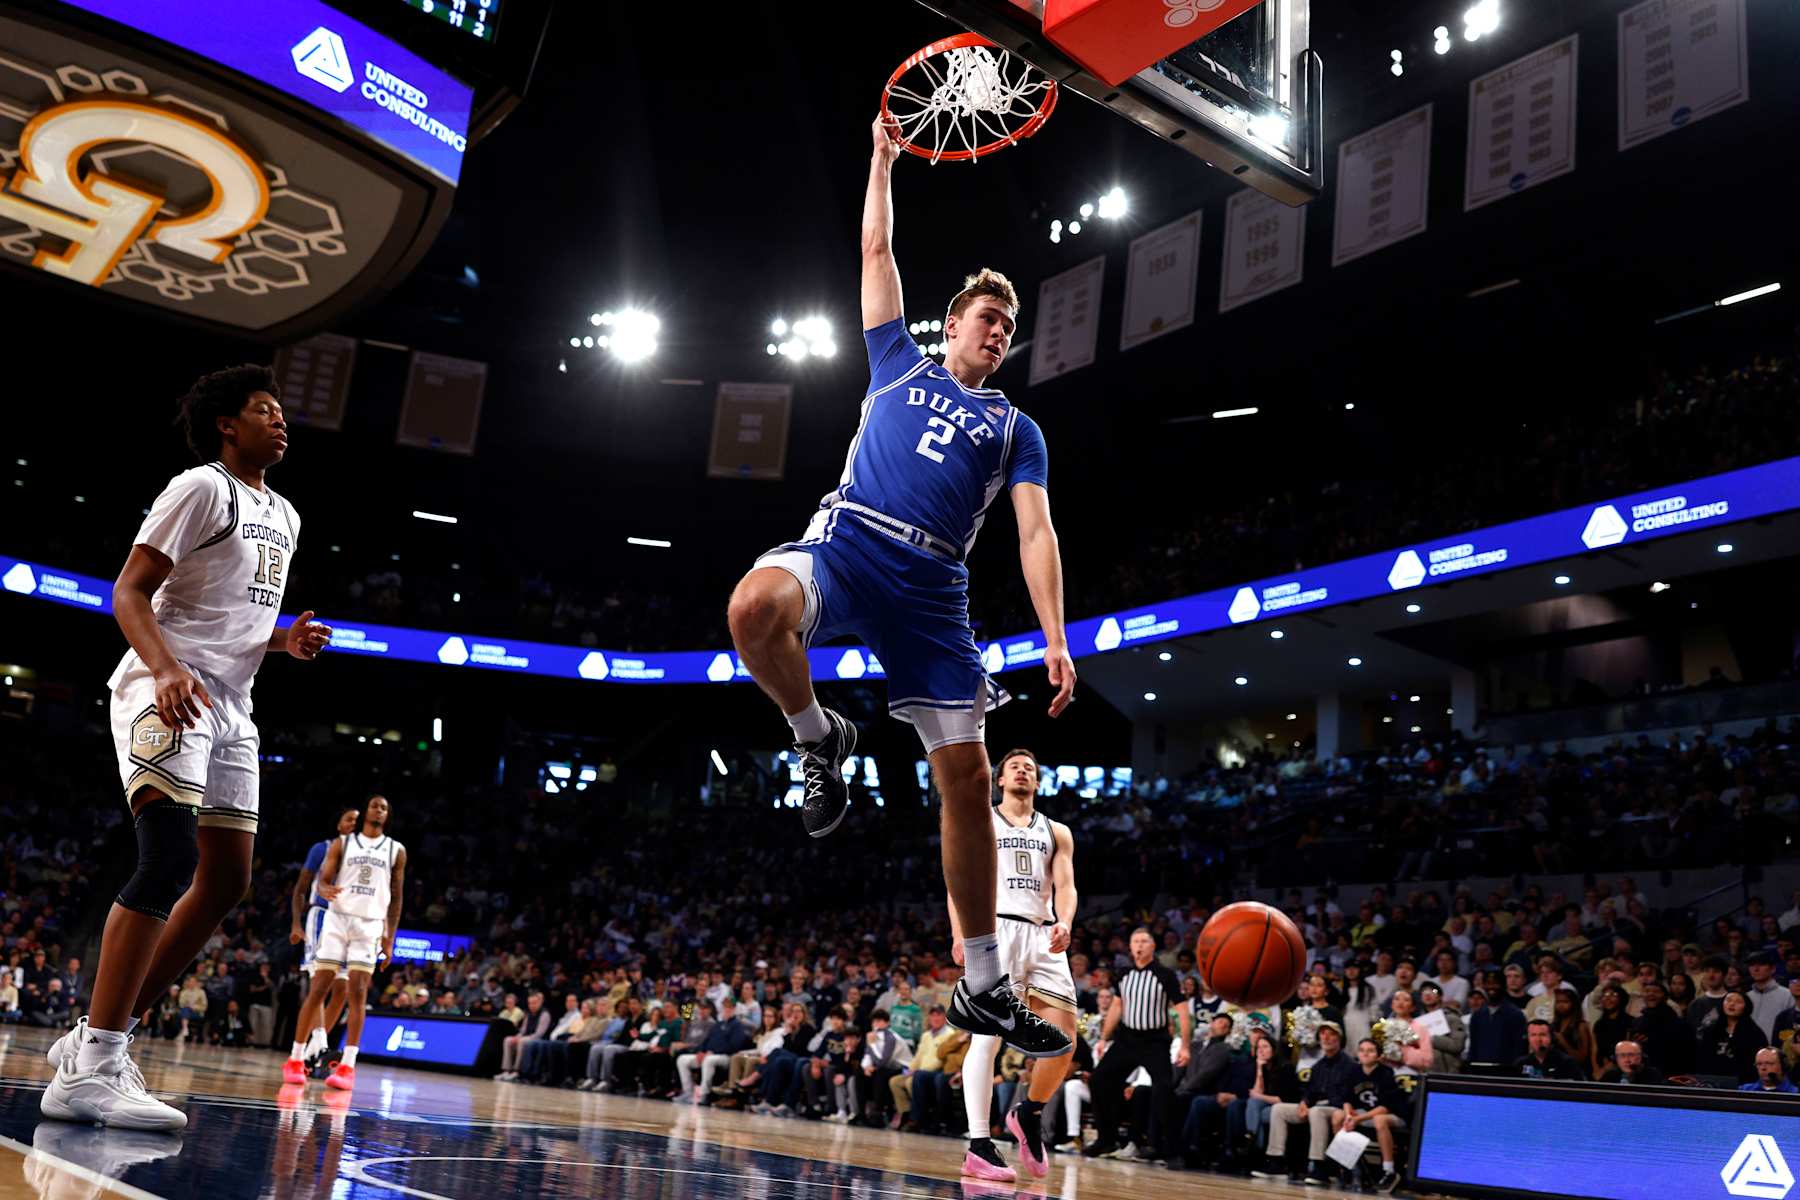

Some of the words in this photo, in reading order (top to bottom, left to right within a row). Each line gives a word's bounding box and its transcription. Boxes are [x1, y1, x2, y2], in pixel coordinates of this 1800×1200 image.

[449, 11, 463, 27] 11
[472, 22, 485, 37] 2
[364, 61, 428, 109] UNITED
[361, 81, 467, 152] CONSULTING
[906, 387, 995, 447] DUKE
[915, 416, 957, 465] 2
[1632, 496, 1688, 519] UNITED
[1632, 501, 1730, 533] CONSULTING
[242, 523, 291, 554] GEORGIA
[254, 543, 284, 588] 12
[247, 586, 280, 609] TECH
[136, 726, 168, 747] GT
[346, 855, 388, 869] GEORGIA
[357, 865, 373, 885] 2
[1015, 850, 1033, 876] 0
[350, 885, 377, 897] TECH
[1007, 878, 1042, 892] TECH
